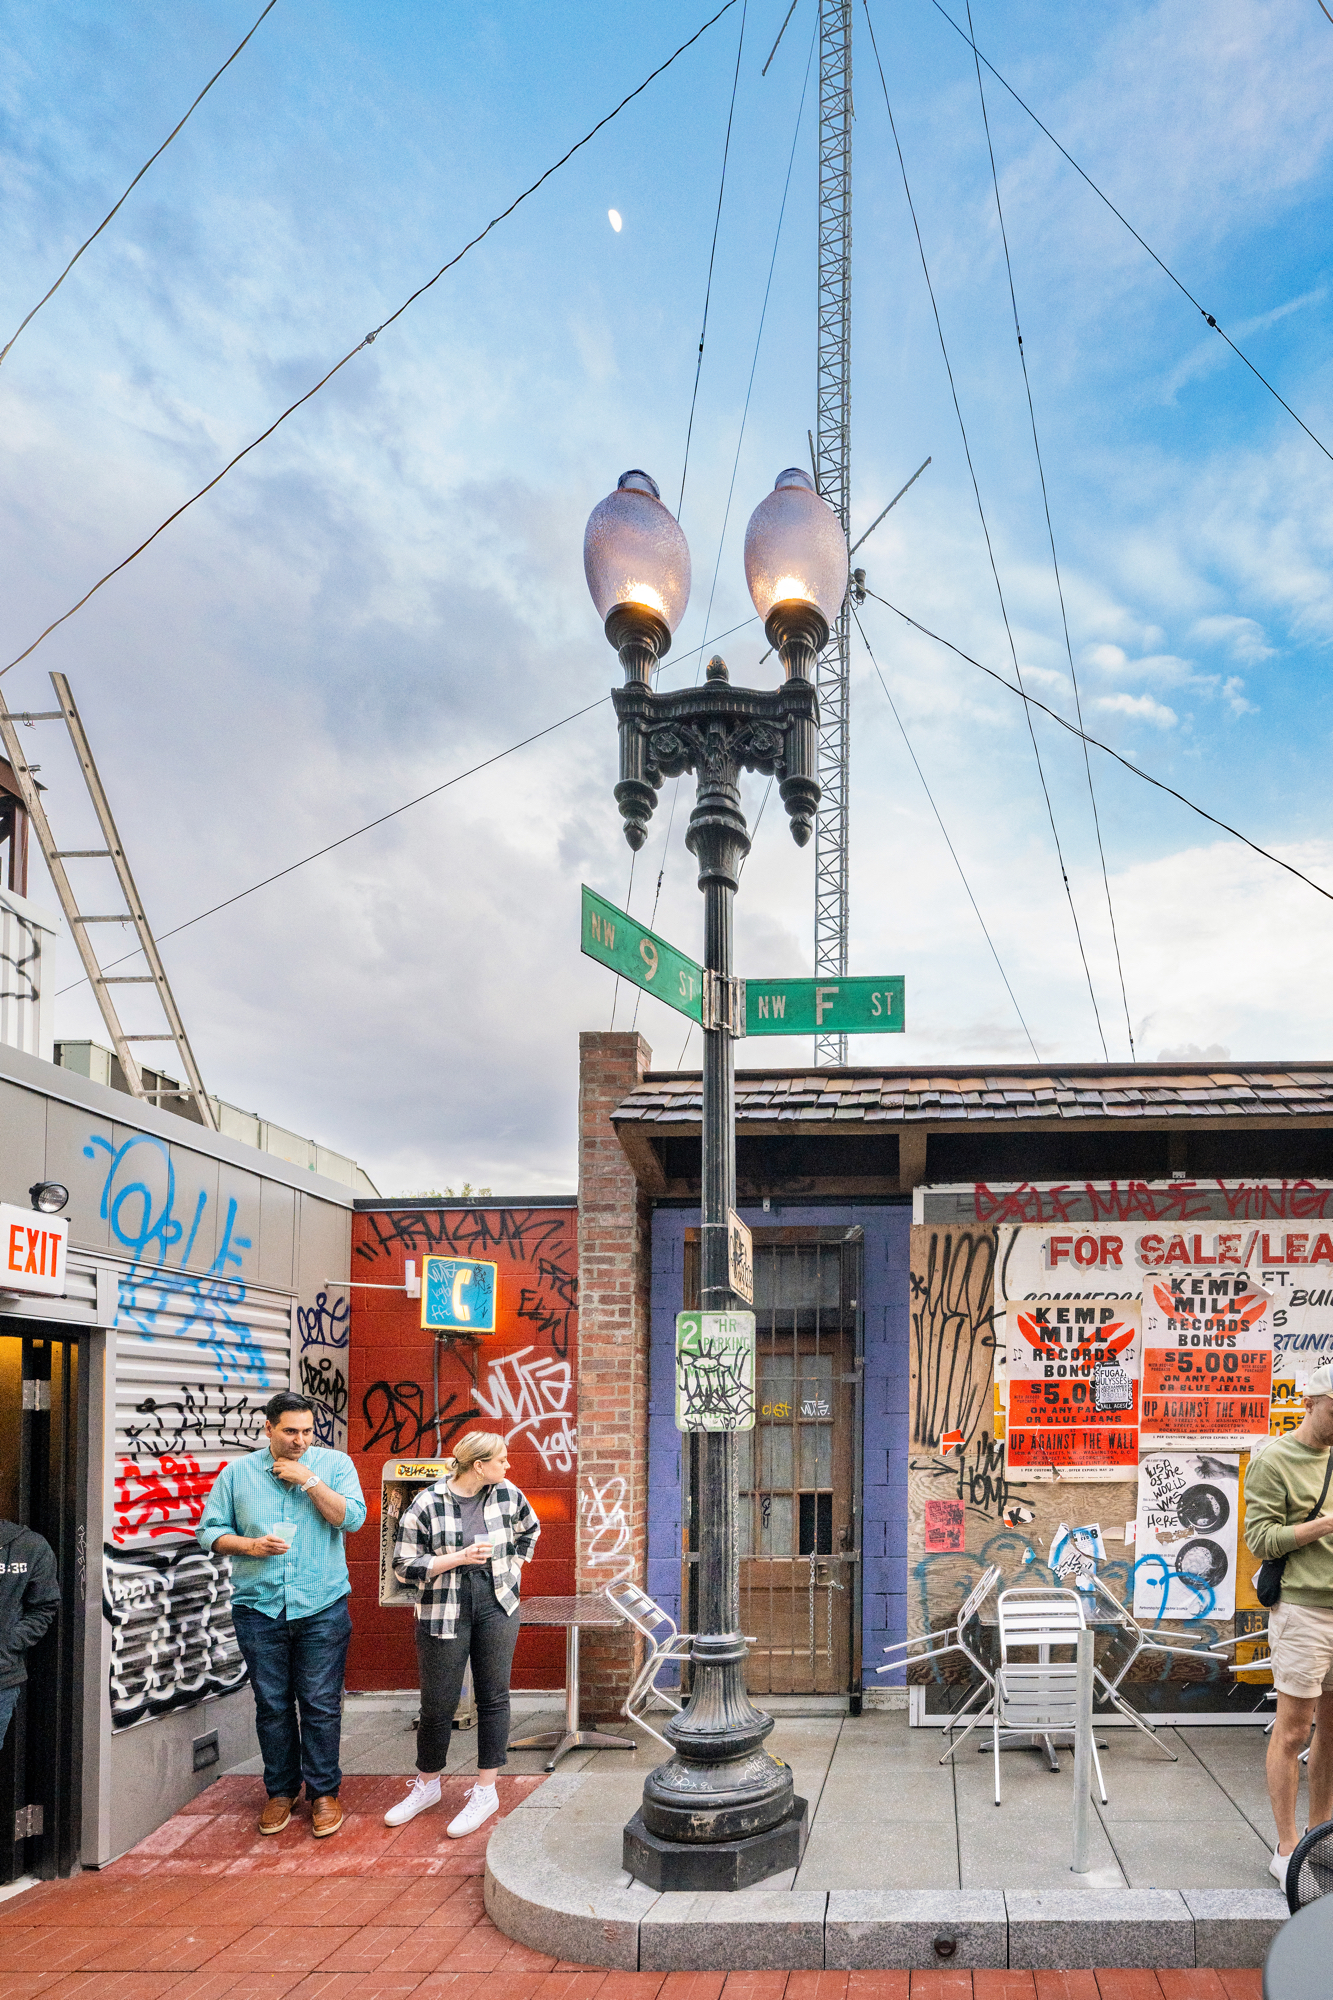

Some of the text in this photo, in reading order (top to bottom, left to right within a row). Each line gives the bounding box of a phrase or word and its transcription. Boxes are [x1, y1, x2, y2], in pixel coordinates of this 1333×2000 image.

[591, 911, 694, 1002] NW 9 ST
[758, 986, 894, 1025] NW F ST
[8, 1224, 62, 1277] EXIT
[1049, 1234, 1124, 1267] FOR
[1170, 1278, 1248, 1296] KEMP
[1174, 1297, 1241, 1314] MILL
[1289, 1289, 1333, 1307] BUI
[1035, 1307, 1114, 1324] KEMP
[719, 1319, 737, 1333] HR
[1167, 1318, 1250, 1332] RECORDS
[682, 1321, 698, 1349] 2
[1040, 1326, 1108, 1342] MILL
[1178, 1334, 1236, 1347] BONUS
[703, 1337, 750, 1351] PARKING
[1032, 1348, 1117, 1361] RECORDS
[1241, 1353, 1267, 1364] OFF
[1044, 1364, 1091, 1377] BONU
[1210, 1375, 1251, 1383] PANTS
[1030, 1406, 1047, 1414] ON
[1051, 1406, 1073, 1414] ANY
[1144, 1401, 1265, 1418] UP AGAINST THE WALL
[1082, 1415, 1122, 1423] JEANS
[1010, 1432, 1135, 1450] UP AGAINST THE WALL
